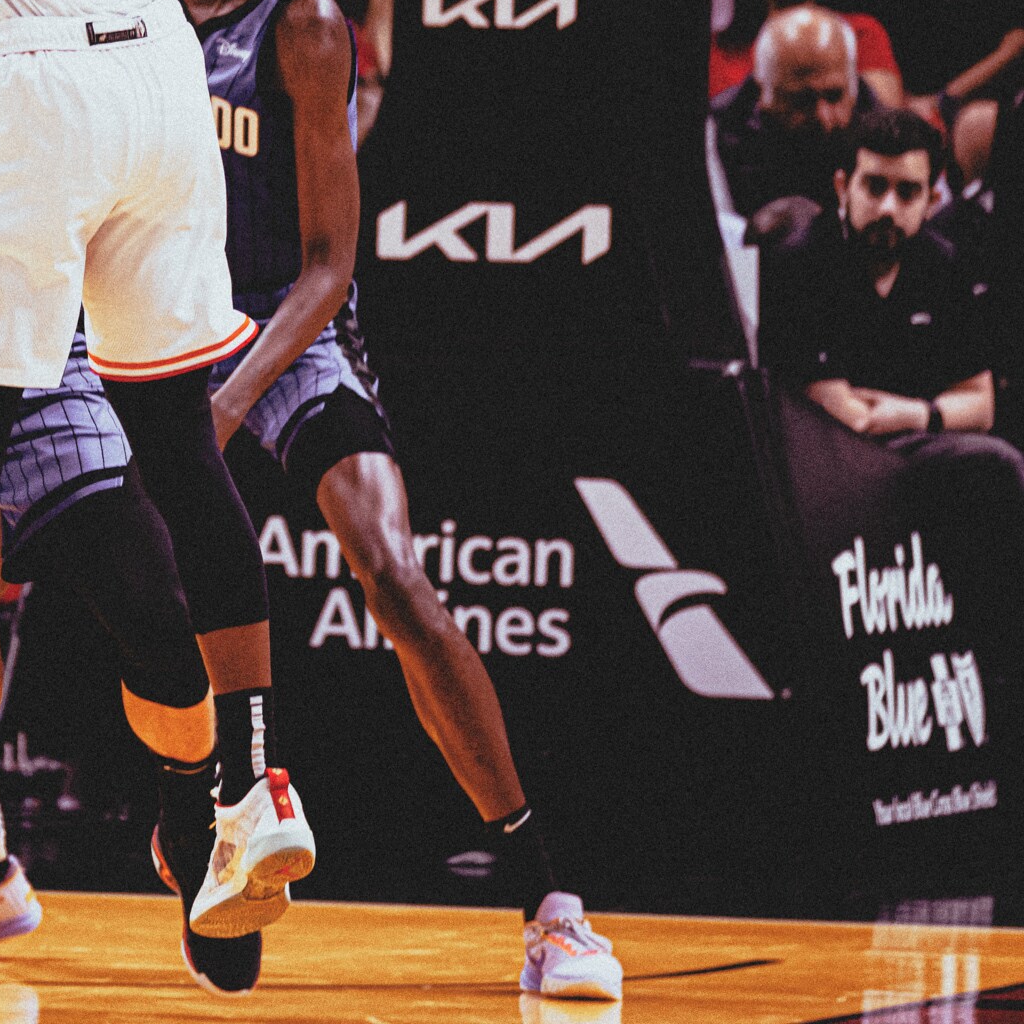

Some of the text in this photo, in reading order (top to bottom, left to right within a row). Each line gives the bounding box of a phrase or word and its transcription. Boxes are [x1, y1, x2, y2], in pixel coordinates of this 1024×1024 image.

[260, 515, 575, 588] Amrican
[831, 530, 954, 640] Florida
[860, 648, 933, 752] Blue
